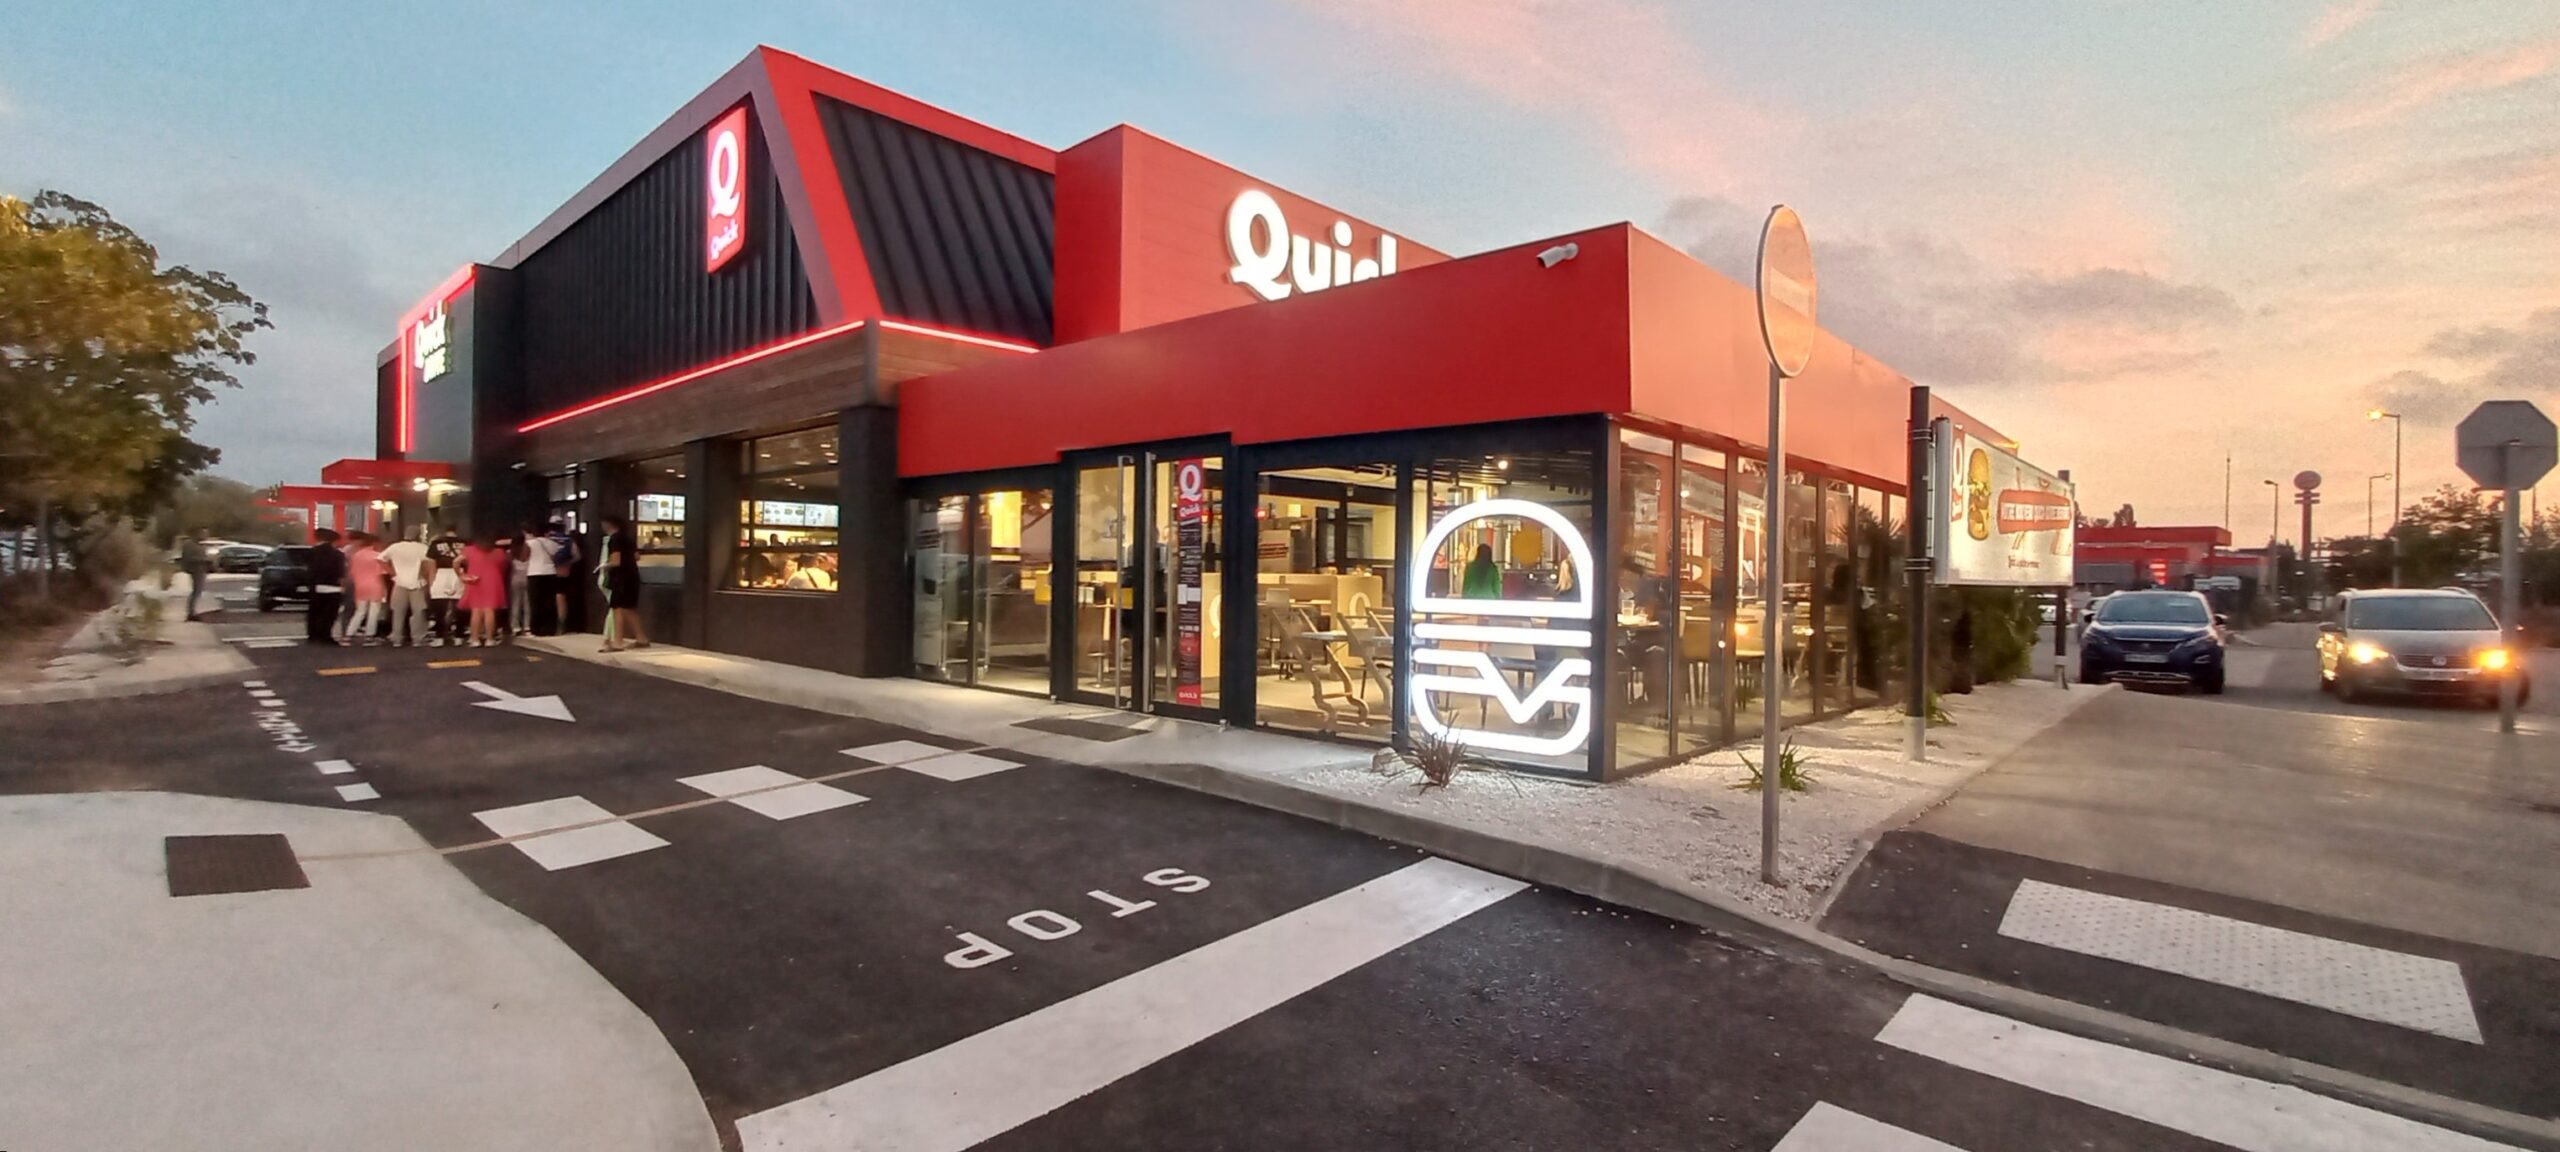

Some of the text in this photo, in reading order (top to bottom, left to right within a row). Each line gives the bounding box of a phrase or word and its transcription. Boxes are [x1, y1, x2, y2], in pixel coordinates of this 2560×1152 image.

[710, 130, 740, 219] Q
[710, 218, 740, 261] Quick
[1179, 463, 1201, 501] Q
[943, 867, 1212, 969] STOP
